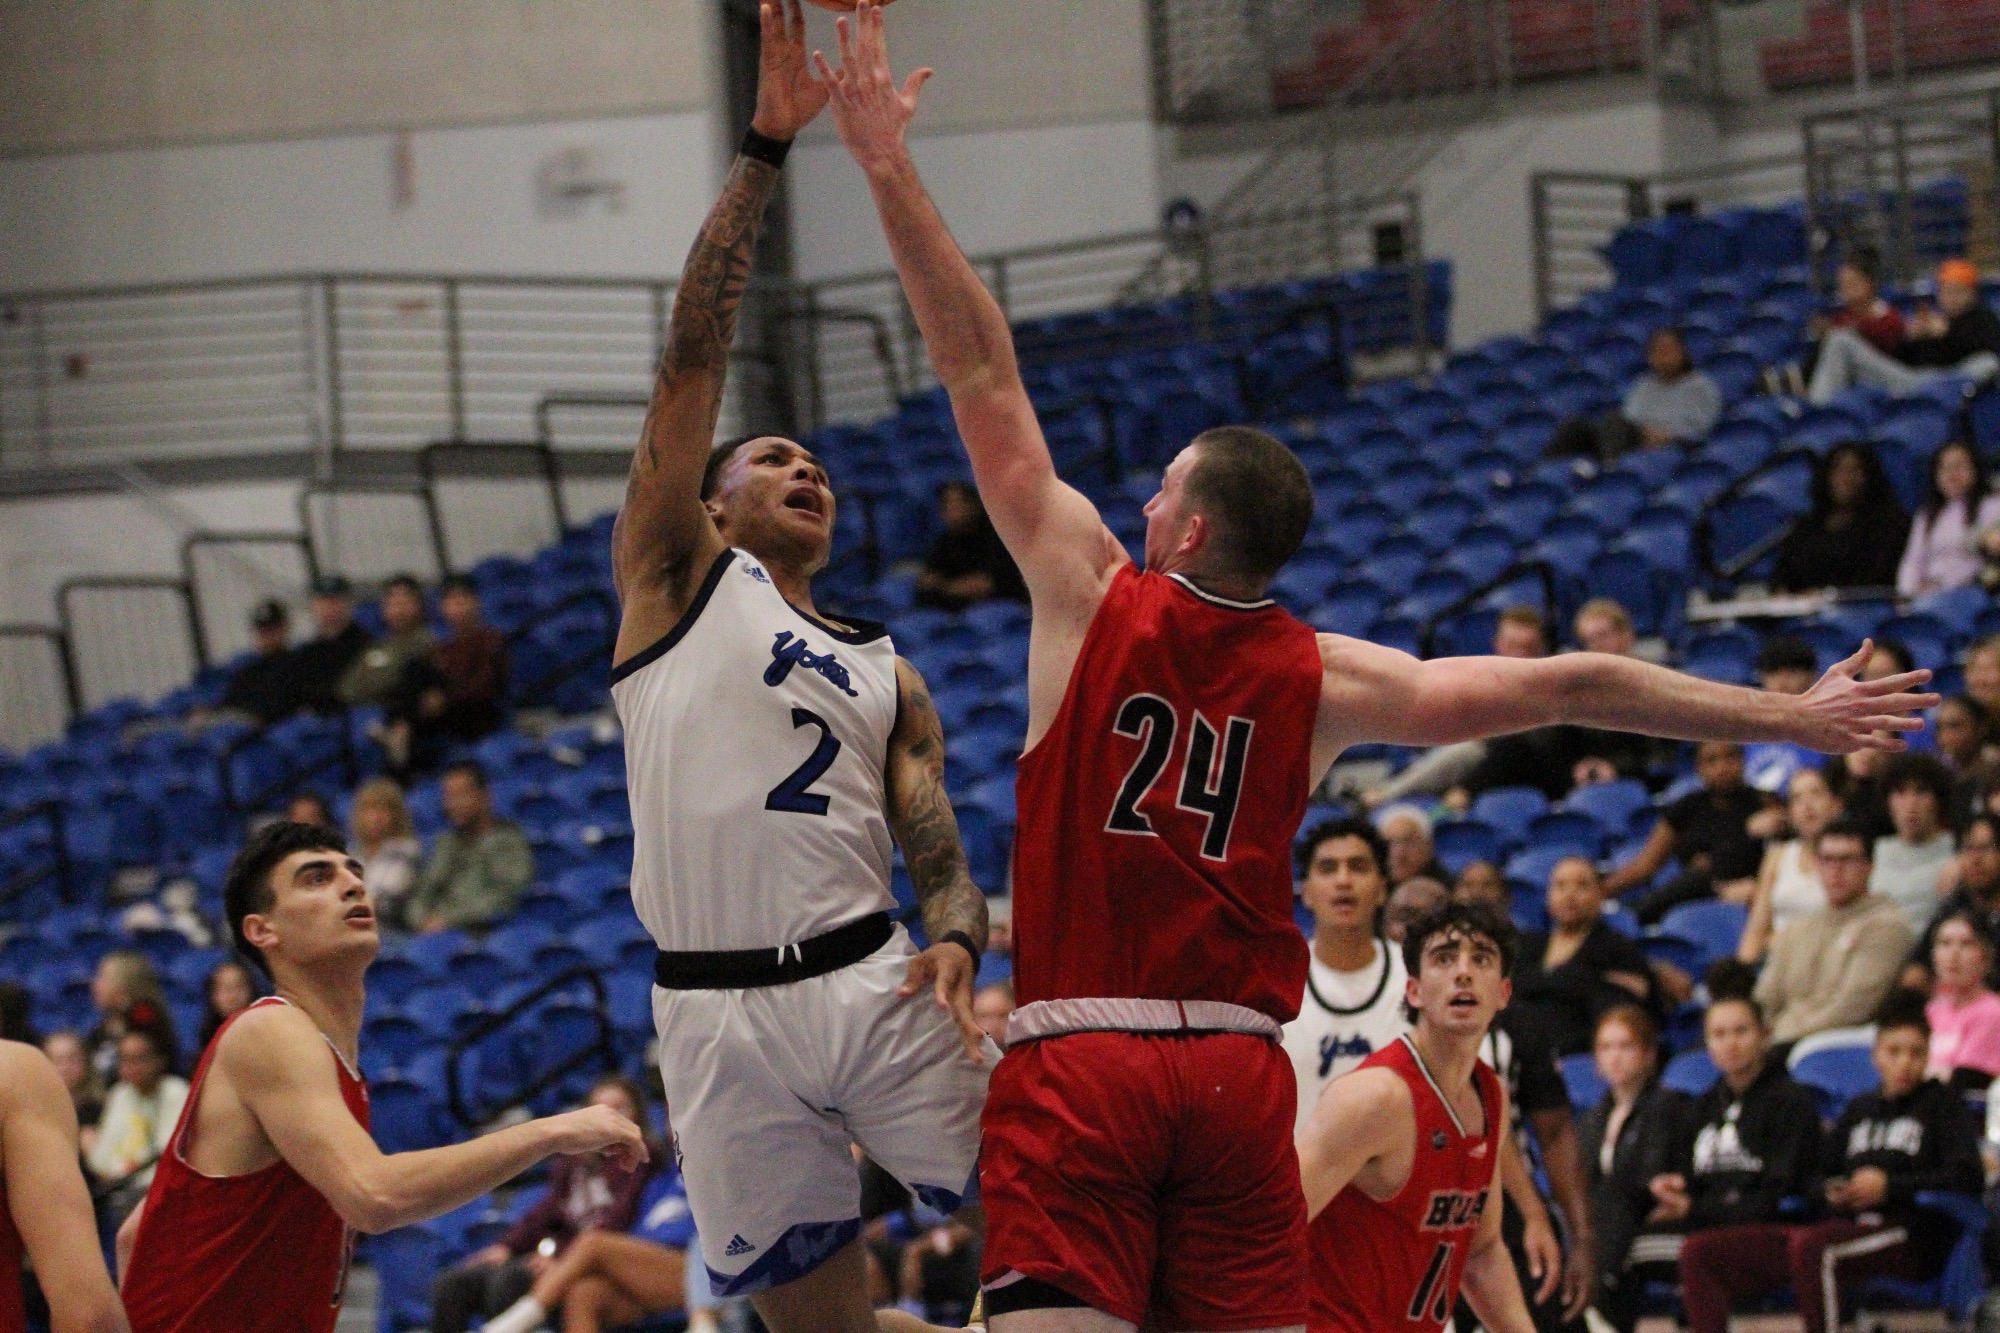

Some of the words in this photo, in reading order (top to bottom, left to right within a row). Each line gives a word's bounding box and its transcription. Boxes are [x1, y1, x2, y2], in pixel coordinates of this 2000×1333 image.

[765, 707, 842, 816] 2
[1104, 692, 1255, 862] 24
[725, 1244, 757, 1257] adidas
